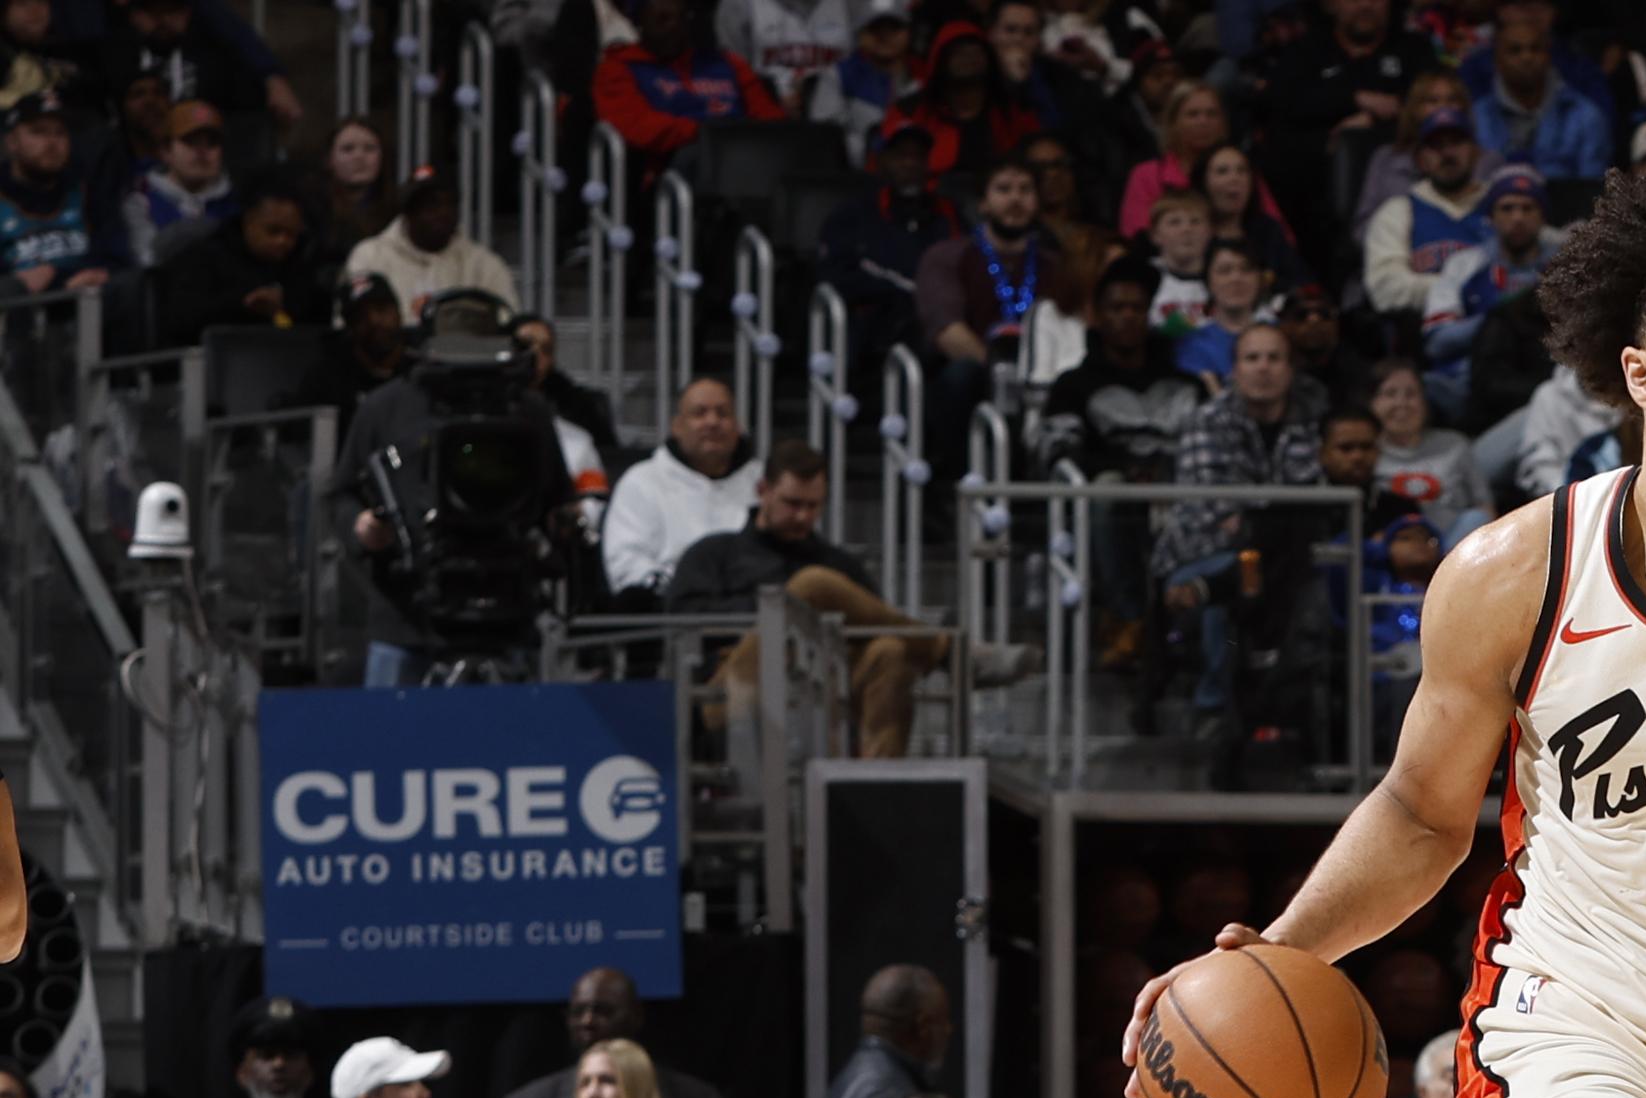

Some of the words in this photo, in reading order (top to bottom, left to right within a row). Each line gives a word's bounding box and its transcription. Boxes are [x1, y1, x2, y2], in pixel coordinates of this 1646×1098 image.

[273, 765, 568, 844] CURE
[276, 853, 391, 886] AUTO
[411, 846, 667, 882] INSURANCE
[339, 921, 514, 951] COURTSIDE
[525, 919, 605, 944] CLUB
